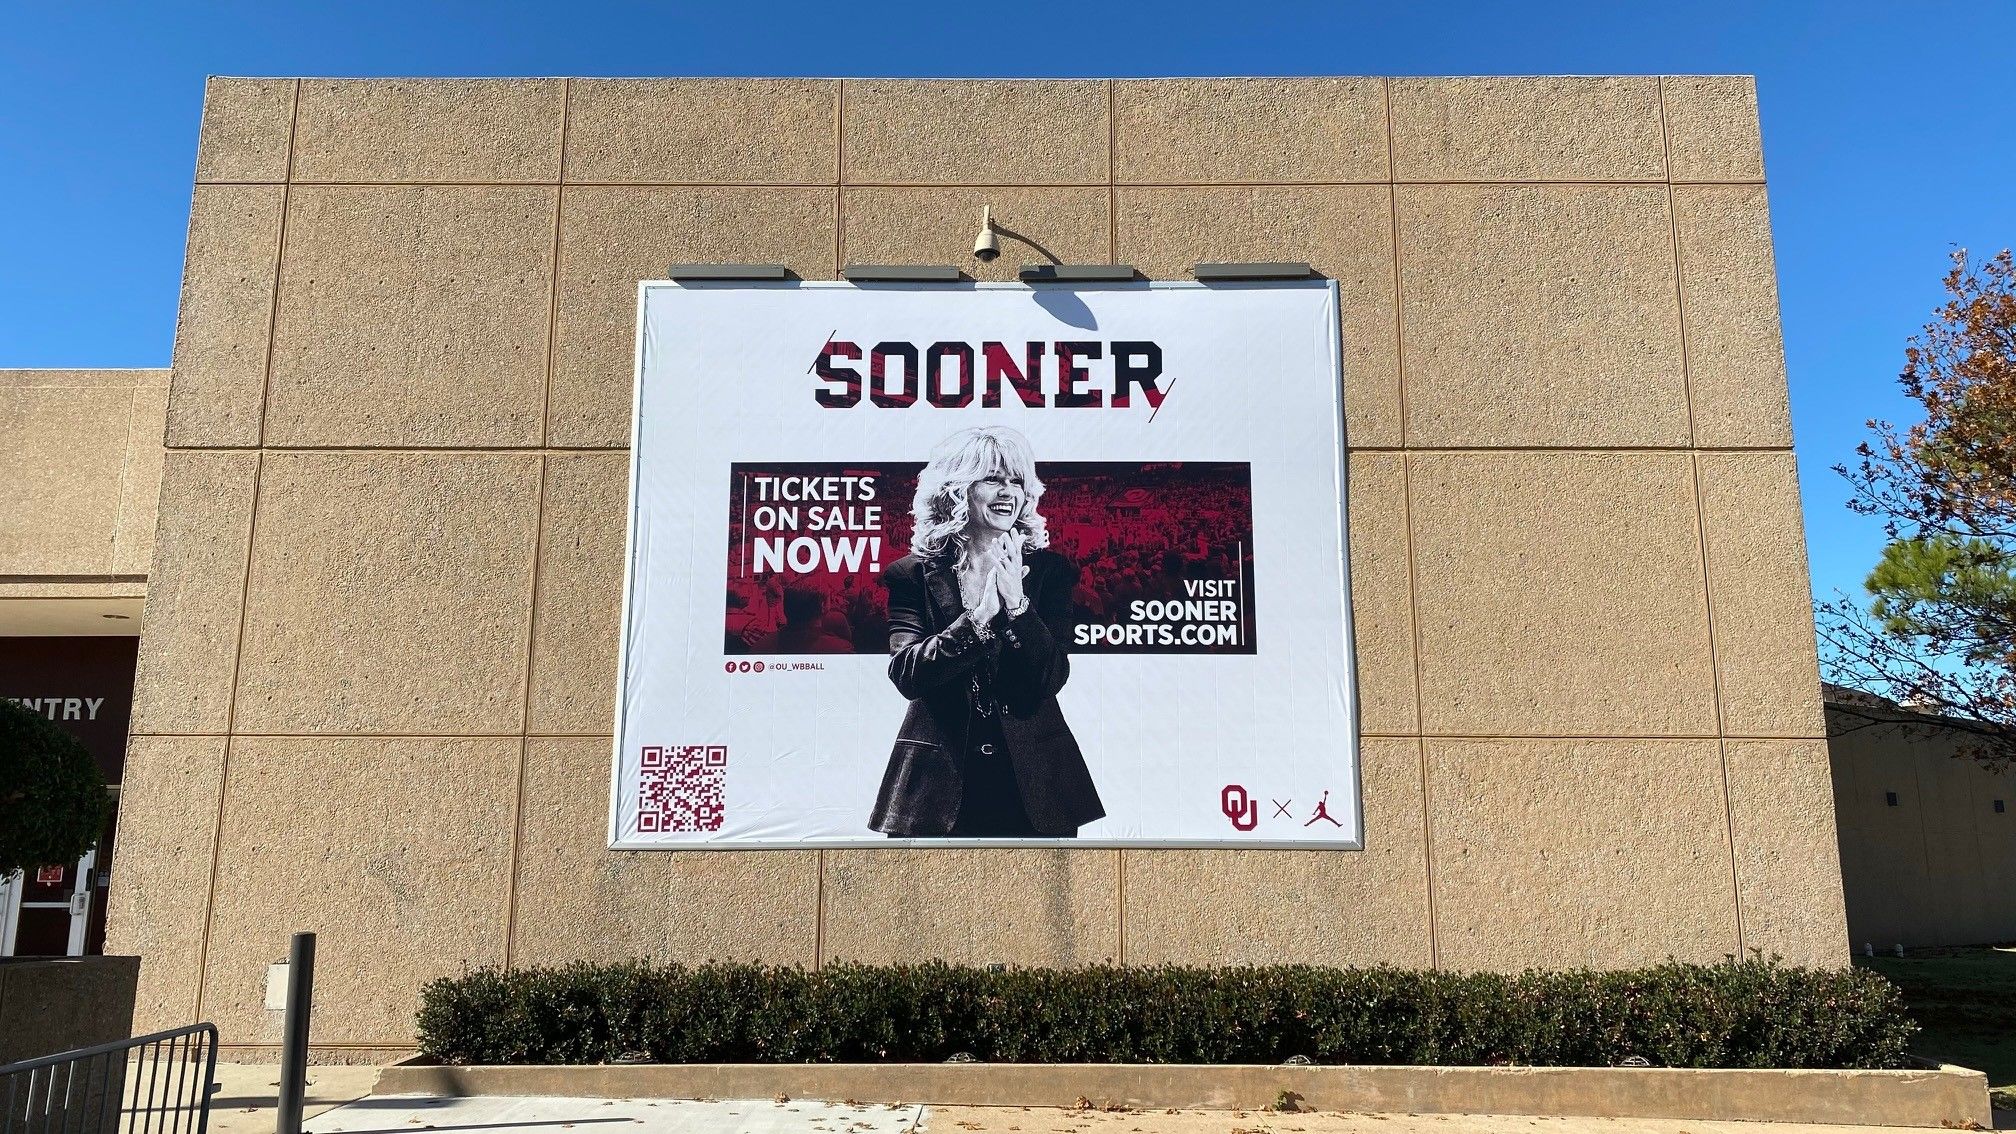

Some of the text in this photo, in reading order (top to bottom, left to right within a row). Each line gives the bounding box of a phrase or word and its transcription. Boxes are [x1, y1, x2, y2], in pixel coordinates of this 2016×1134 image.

[814, 340, 1170, 409] SOONER
[754, 476, 876, 501] TICKETS
[753, 506, 882, 531] ON SALE
[753, 536, 881, 574] NOW!
[1183, 579, 1236, 598] VISIT
[1130, 600, 1237, 621] SOONER
[1073, 624, 1237, 645] SPORTS.COM
[769, 662, 825, 672] @OU_WBBALL
[8, 697, 104, 721] NTRY
[1221, 784, 1258, 832] OU
